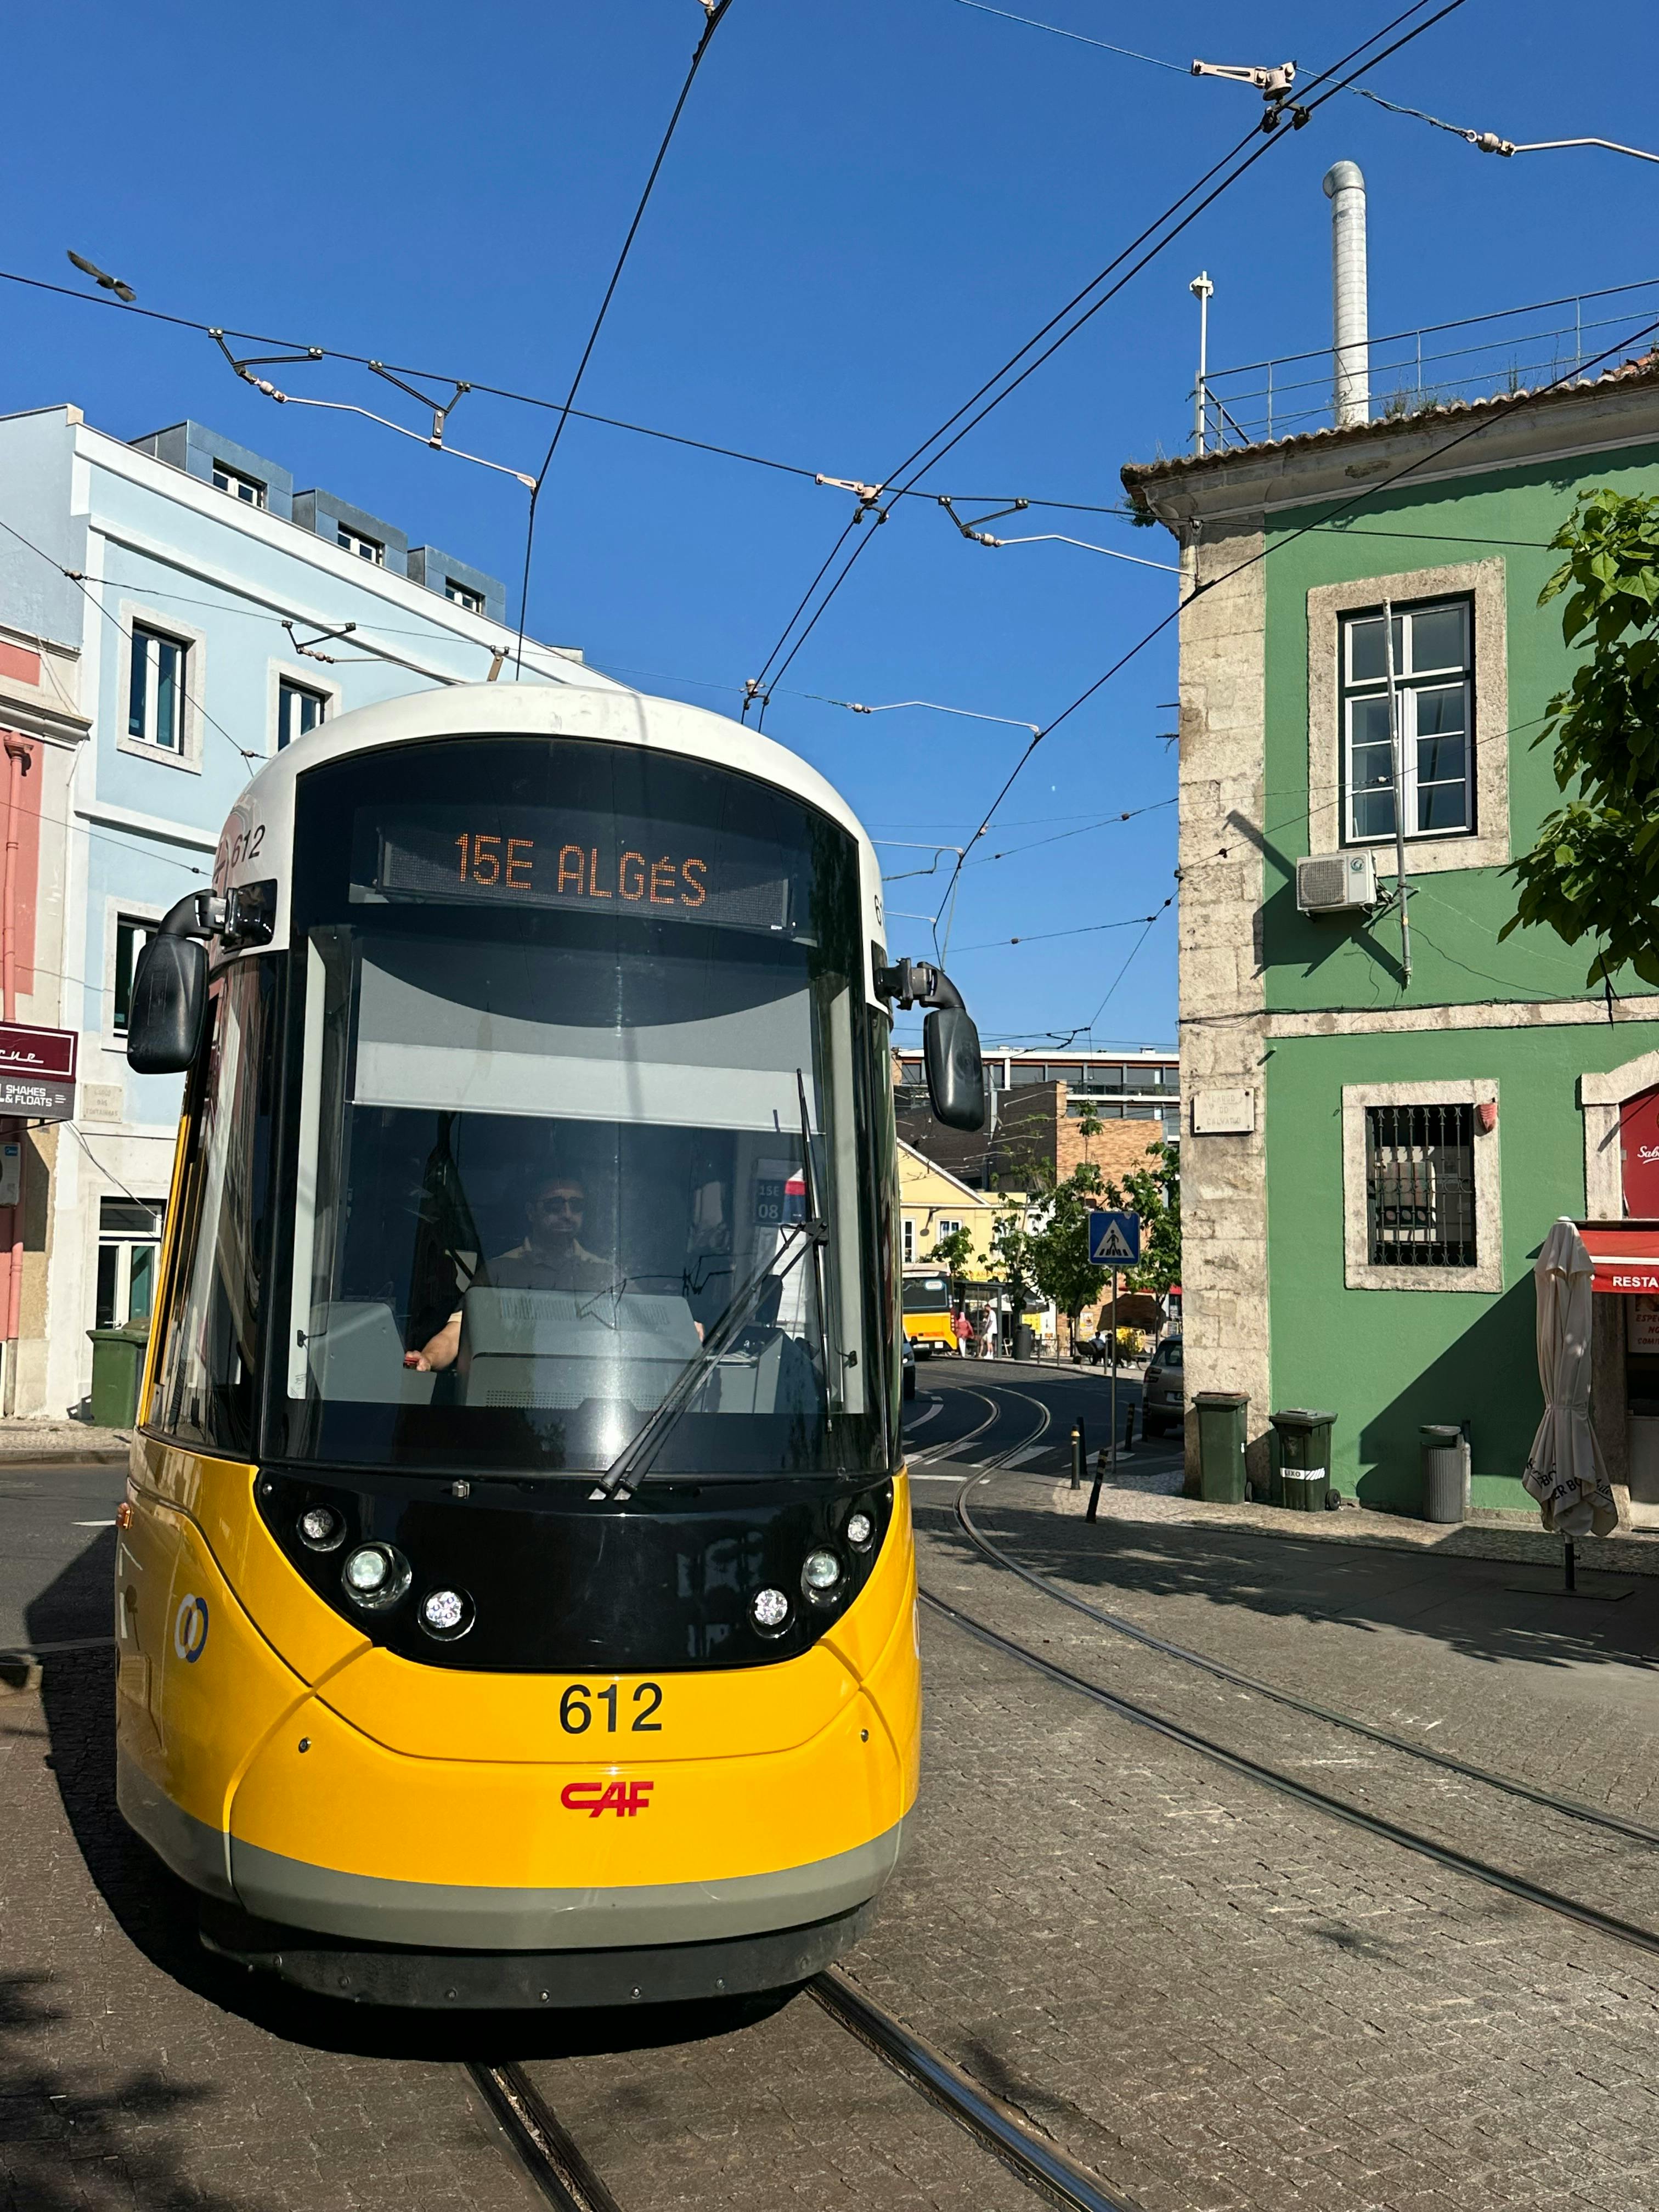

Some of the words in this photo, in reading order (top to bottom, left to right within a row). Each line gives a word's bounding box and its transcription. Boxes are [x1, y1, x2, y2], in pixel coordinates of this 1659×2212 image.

[230, 824, 266, 868] 612
[454, 833, 534, 890] 15E
[557, 844, 707, 907] ALGÉS
[6, 1084, 46, 1097] SHAKES
[5, 1094, 14, 1103] &
[15, 1094, 53, 1107] FLOATS
[1637, 1146, 1659, 1158] Sab
[758, 1203, 779, 1220] 08
[1612, 1276, 1659, 1288] RESTA
[560, 1682, 663, 1735] 612
[561, 1781, 654, 1818] CAF
